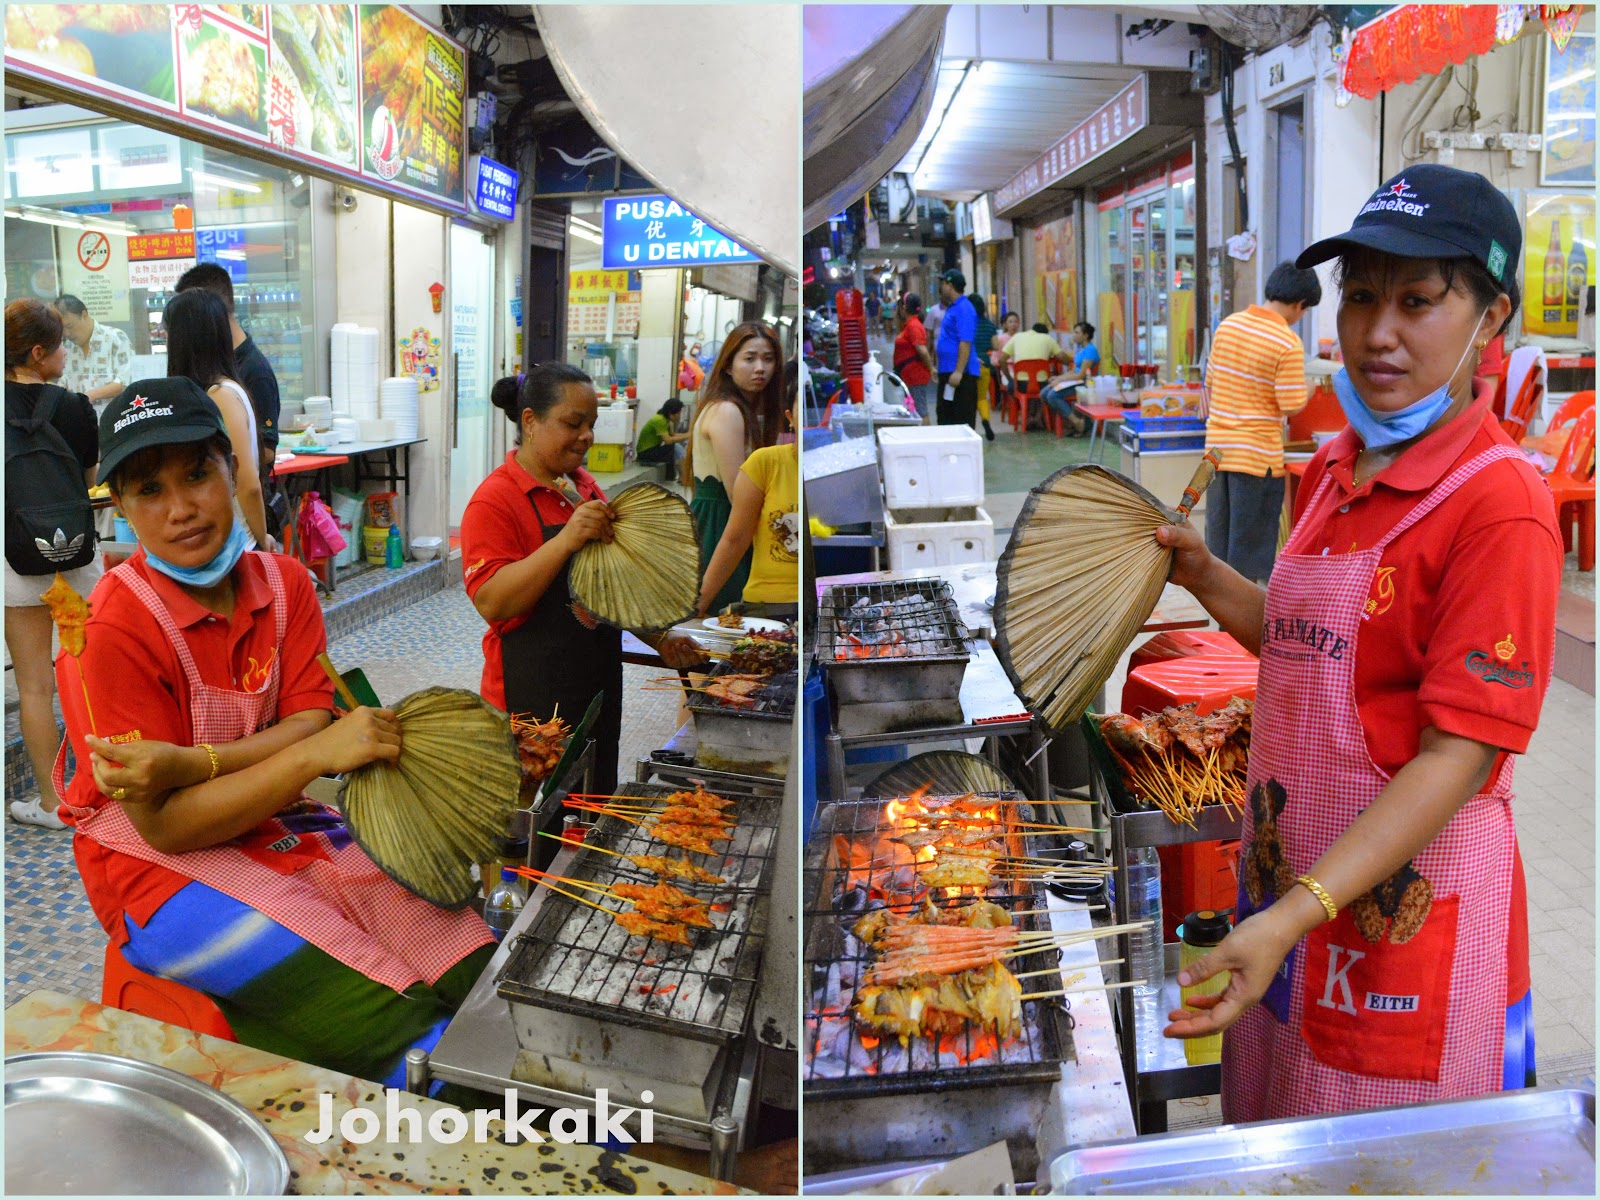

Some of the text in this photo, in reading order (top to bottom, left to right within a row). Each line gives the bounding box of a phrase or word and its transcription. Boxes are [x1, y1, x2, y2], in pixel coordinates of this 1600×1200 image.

[421, 65, 463, 146] 正宗
[615, 200, 692, 221] PUSA
[131, 249, 146, 257] BBQ
[153, 248, 169, 256] Beer
[175, 246, 192, 255] Drink
[623, 239, 749, 262] U DENTAL
[131, 275, 149, 285] Please
[150, 274, 160, 286] Pay
[161, 275, 176, 285] upon
[113, 406, 174, 434] Heineken
[1465, 650, 1535, 688] Carlsberg
[1316, 943, 1415, 1017] K EITH
